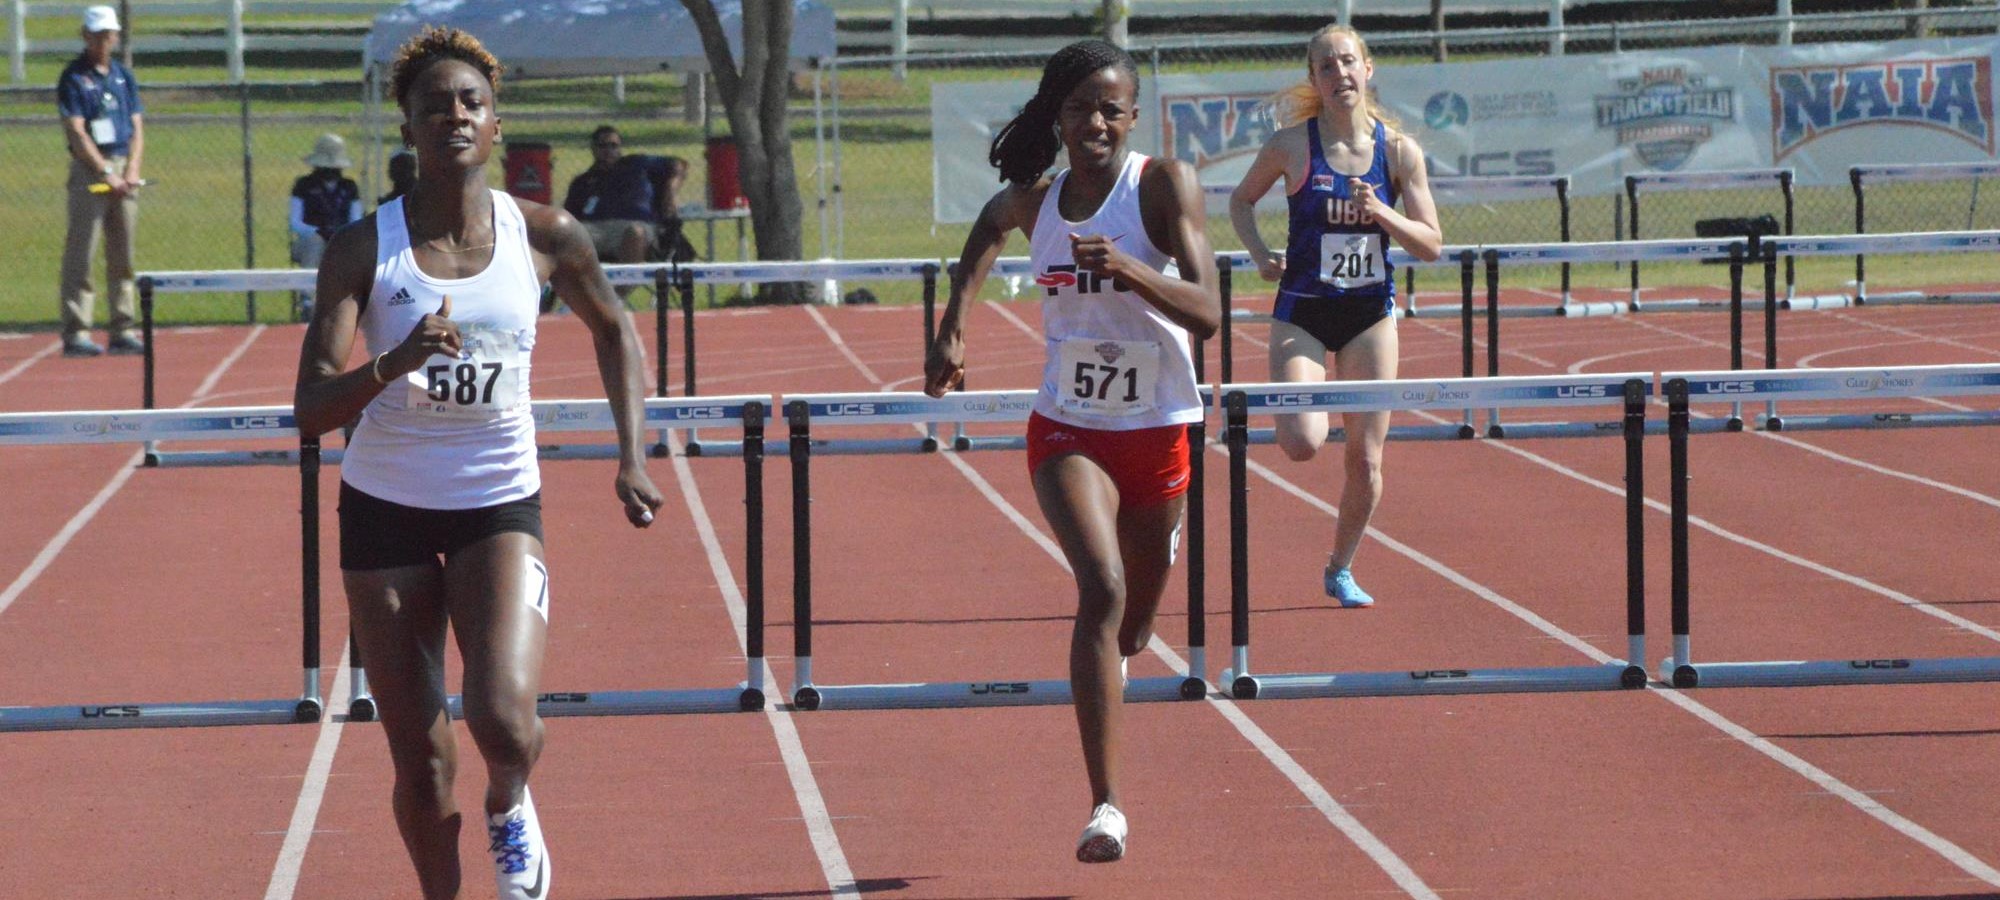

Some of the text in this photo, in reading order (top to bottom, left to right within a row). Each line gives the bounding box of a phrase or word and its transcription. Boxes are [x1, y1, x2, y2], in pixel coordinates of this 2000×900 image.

[1776, 62, 1987, 149] NAIA
[1425, 149, 1555, 176] UCS
[1331, 252, 1376, 278] 201
[387, 298, 416, 307] adidas
[427, 362, 503, 406] 587
[1074, 361, 1139, 402] 571
[1707, 381, 1755, 393] UCS
[1557, 385, 1606, 398] UCS
[1265, 393, 1314, 406] UCS
[676, 406, 724, 419] UCS
[827, 403, 875, 416] UCS
[230, 416, 280, 429] UCS
[1851, 659, 1910, 669] UCS
[1410, 669, 1468, 680] UCS
[970, 682, 1030, 695] UCS
[81, 706, 140, 718] UCS
